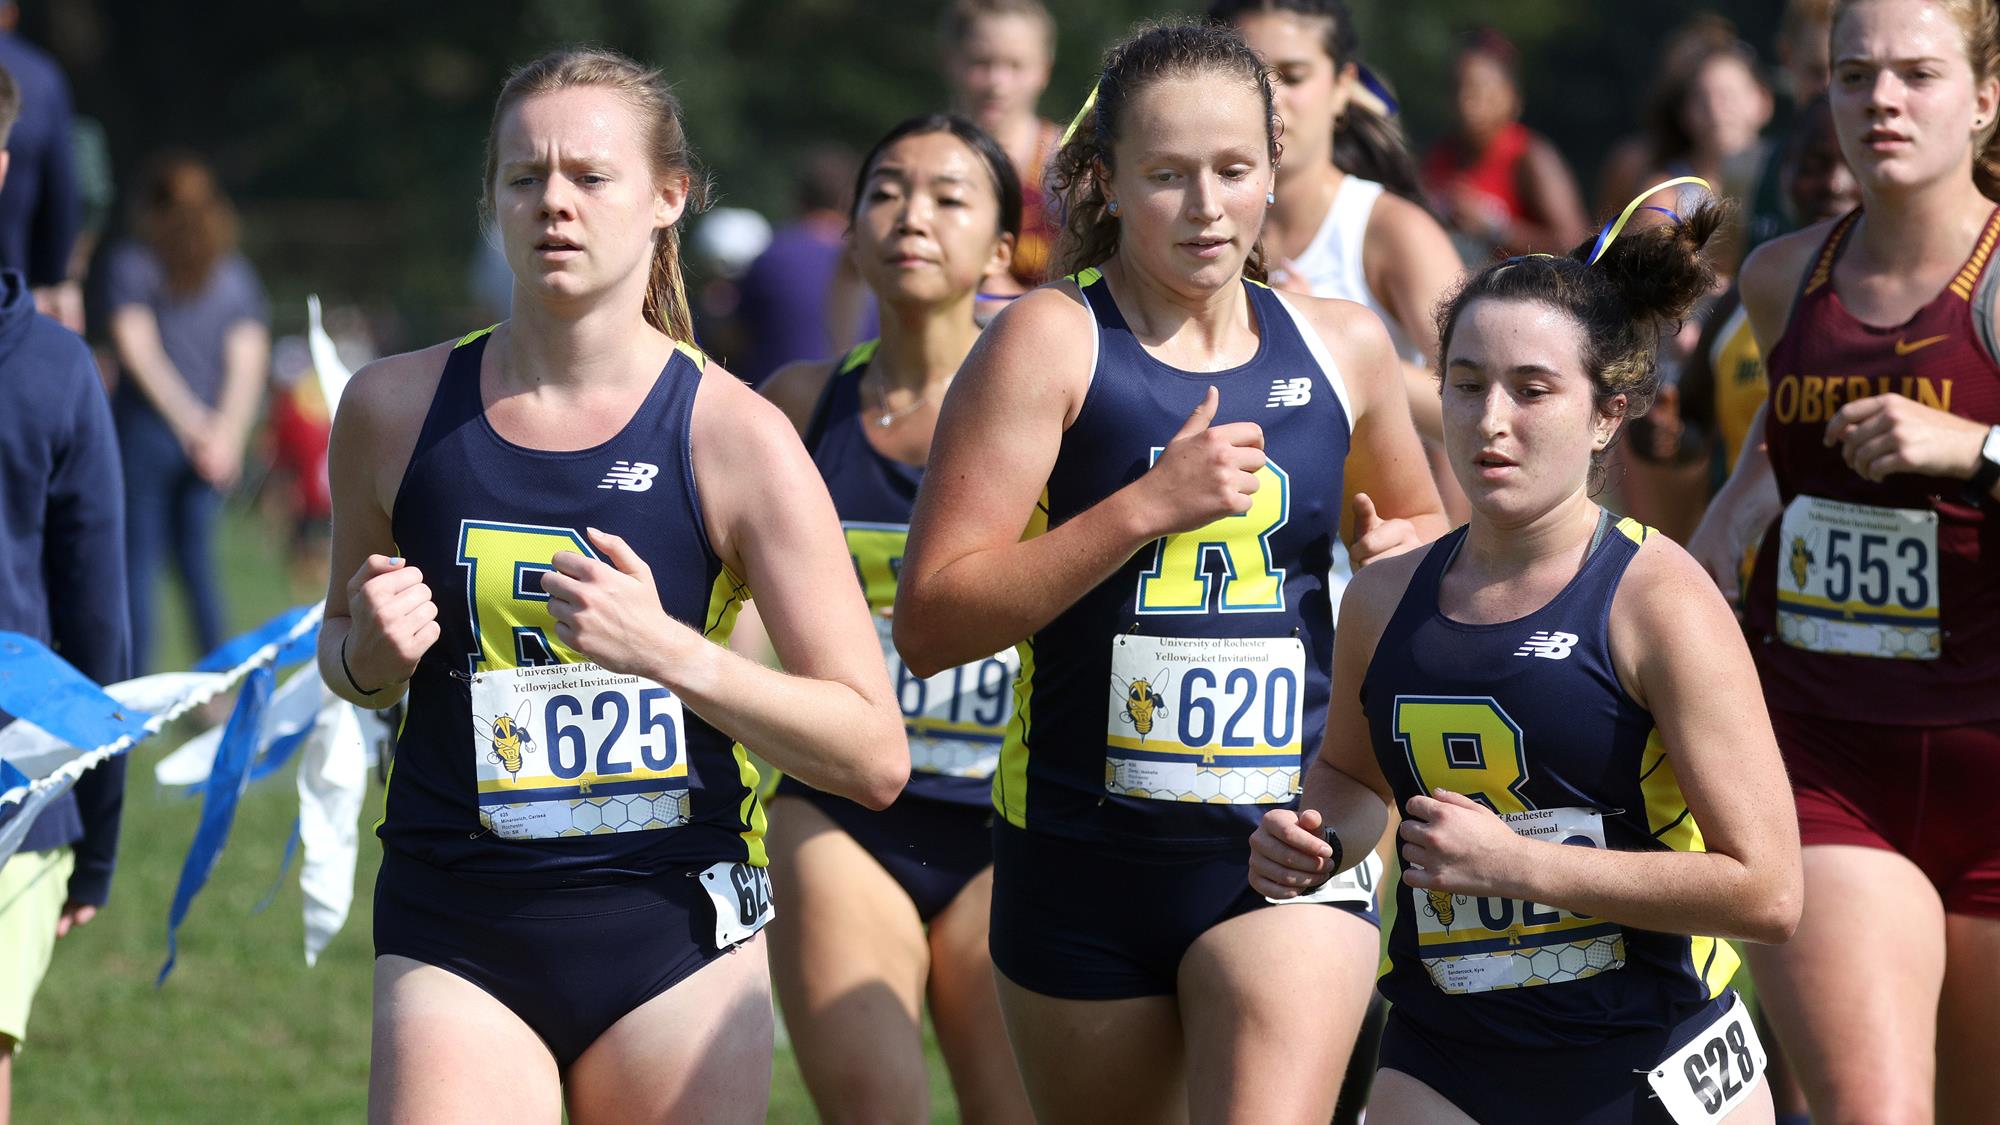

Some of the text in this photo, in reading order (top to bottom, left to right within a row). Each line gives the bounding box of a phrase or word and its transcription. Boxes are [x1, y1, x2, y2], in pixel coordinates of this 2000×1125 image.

[1135, 447, 1291, 615] R
[1824, 528, 1929, 610] 553
[516, 665, 569, 677] University
[572, 664, 582, 673] of
[1155, 652, 1269, 664] Yellowjacket Invitational
[1160, 638, 1266, 650] University of Rochester
[513, 675, 639, 693] Yellowjacket Invitational
[897, 657, 1008, 726] 619
[1178, 667, 1297, 748] 620
[544, 687, 678, 780] 625
[1392, 695, 1538, 813] R
[1505, 810, 1554, 823] Rochester
[1515, 823, 1559, 836] itational
[1683, 1020, 1754, 1115] 628
